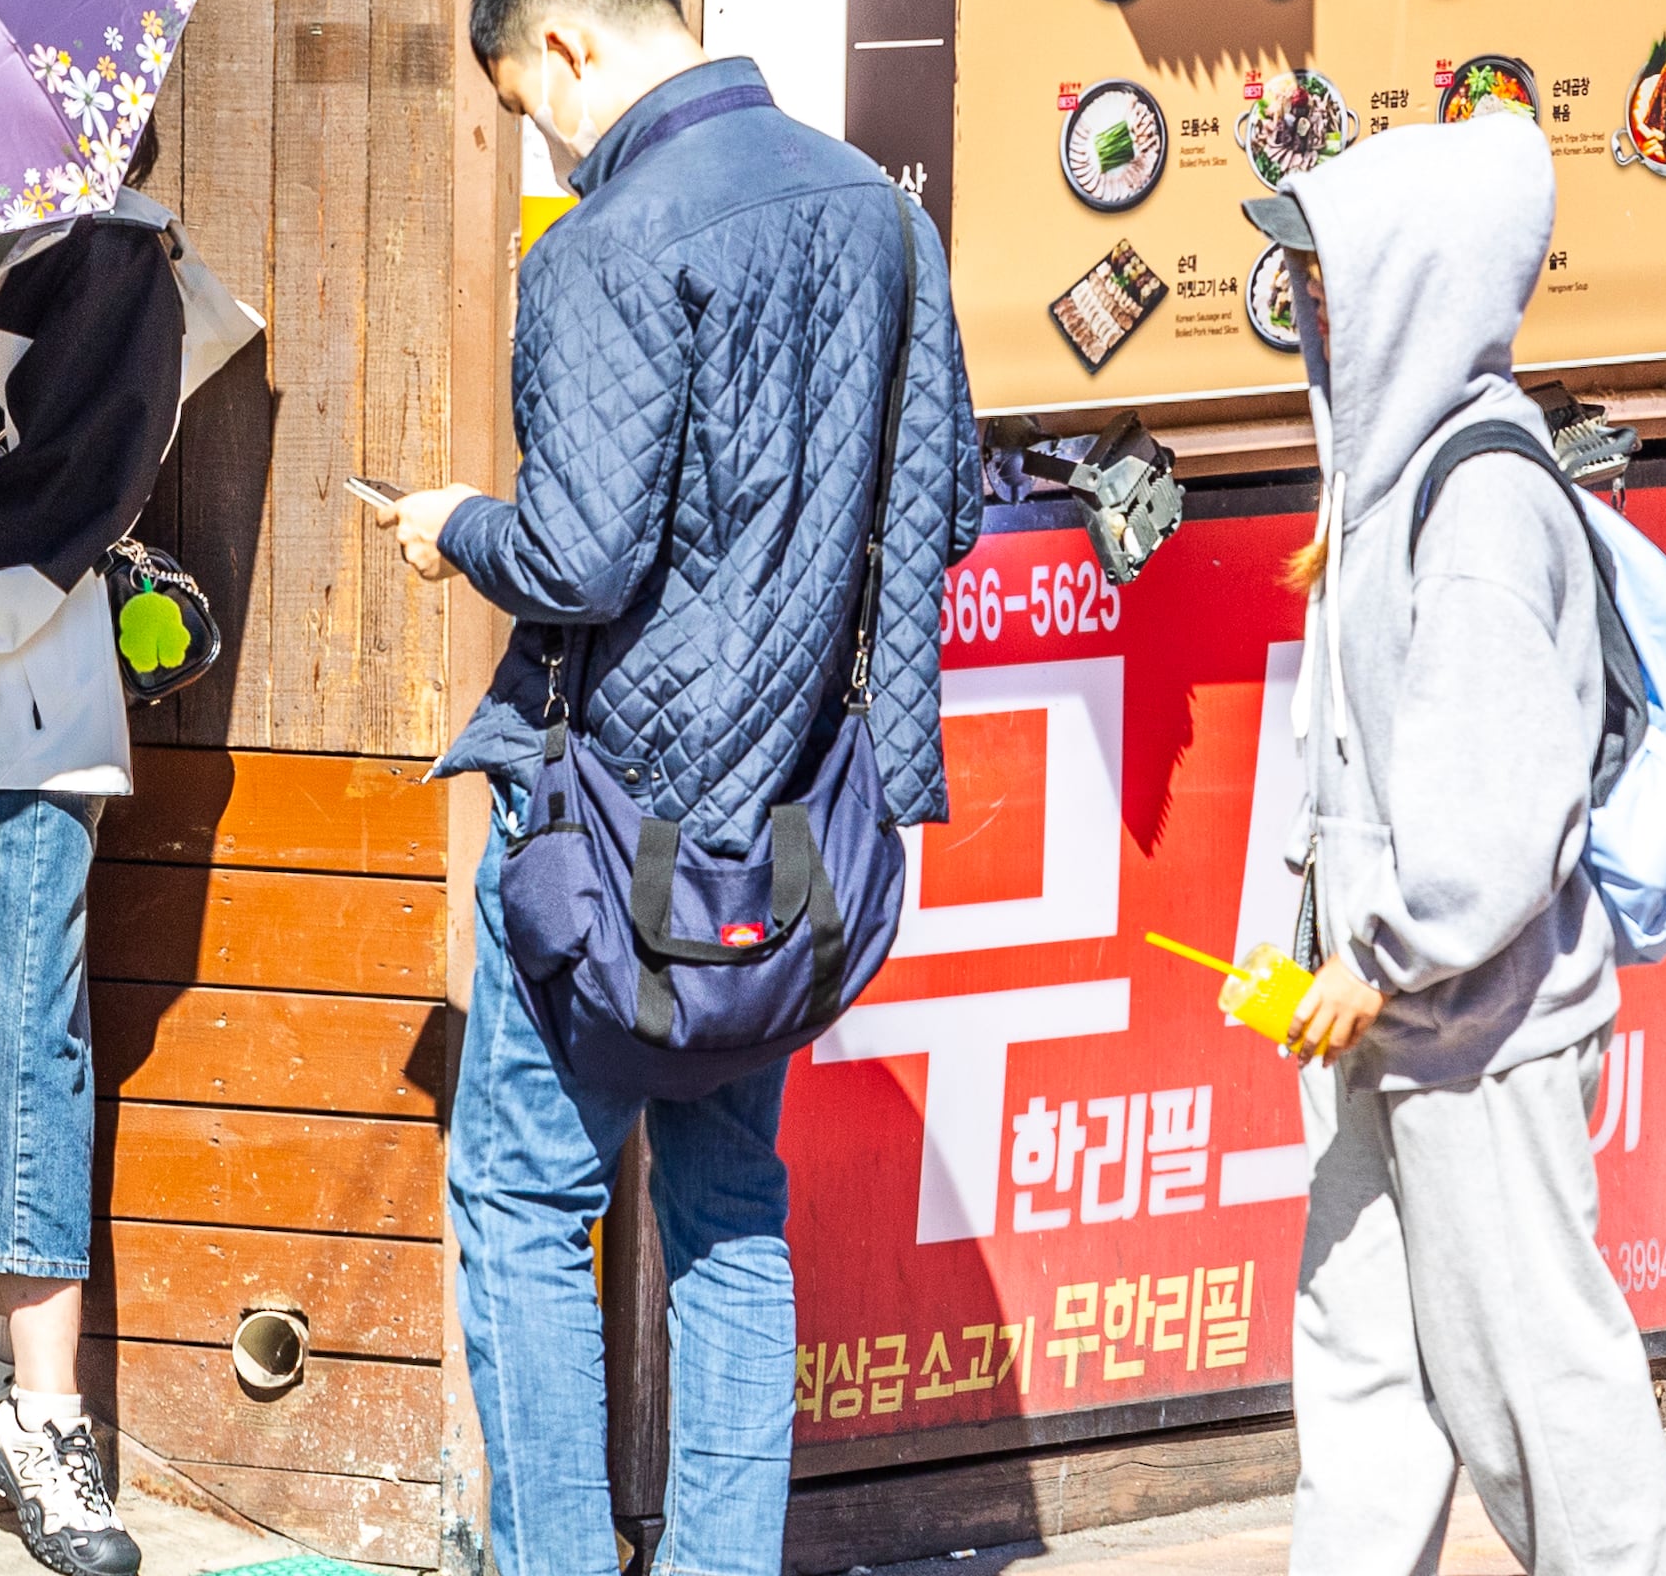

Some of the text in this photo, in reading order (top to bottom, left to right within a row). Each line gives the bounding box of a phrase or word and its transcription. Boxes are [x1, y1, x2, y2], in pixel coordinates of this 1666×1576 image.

[1436, 74, 1453, 86] BEST
[1552, 77, 1590, 97] 순대곱창
[1244, 85, 1261, 97] BEST
[1370, 89, 1409, 109] 순대곱창
[1178, 255, 1197, 274] 순대
[1219, 277, 1238, 297] 수육
[1010, 1084, 1213, 1235] 한리필
[796, 1259, 1256, 1423] 최상급 소고기 무한리필
